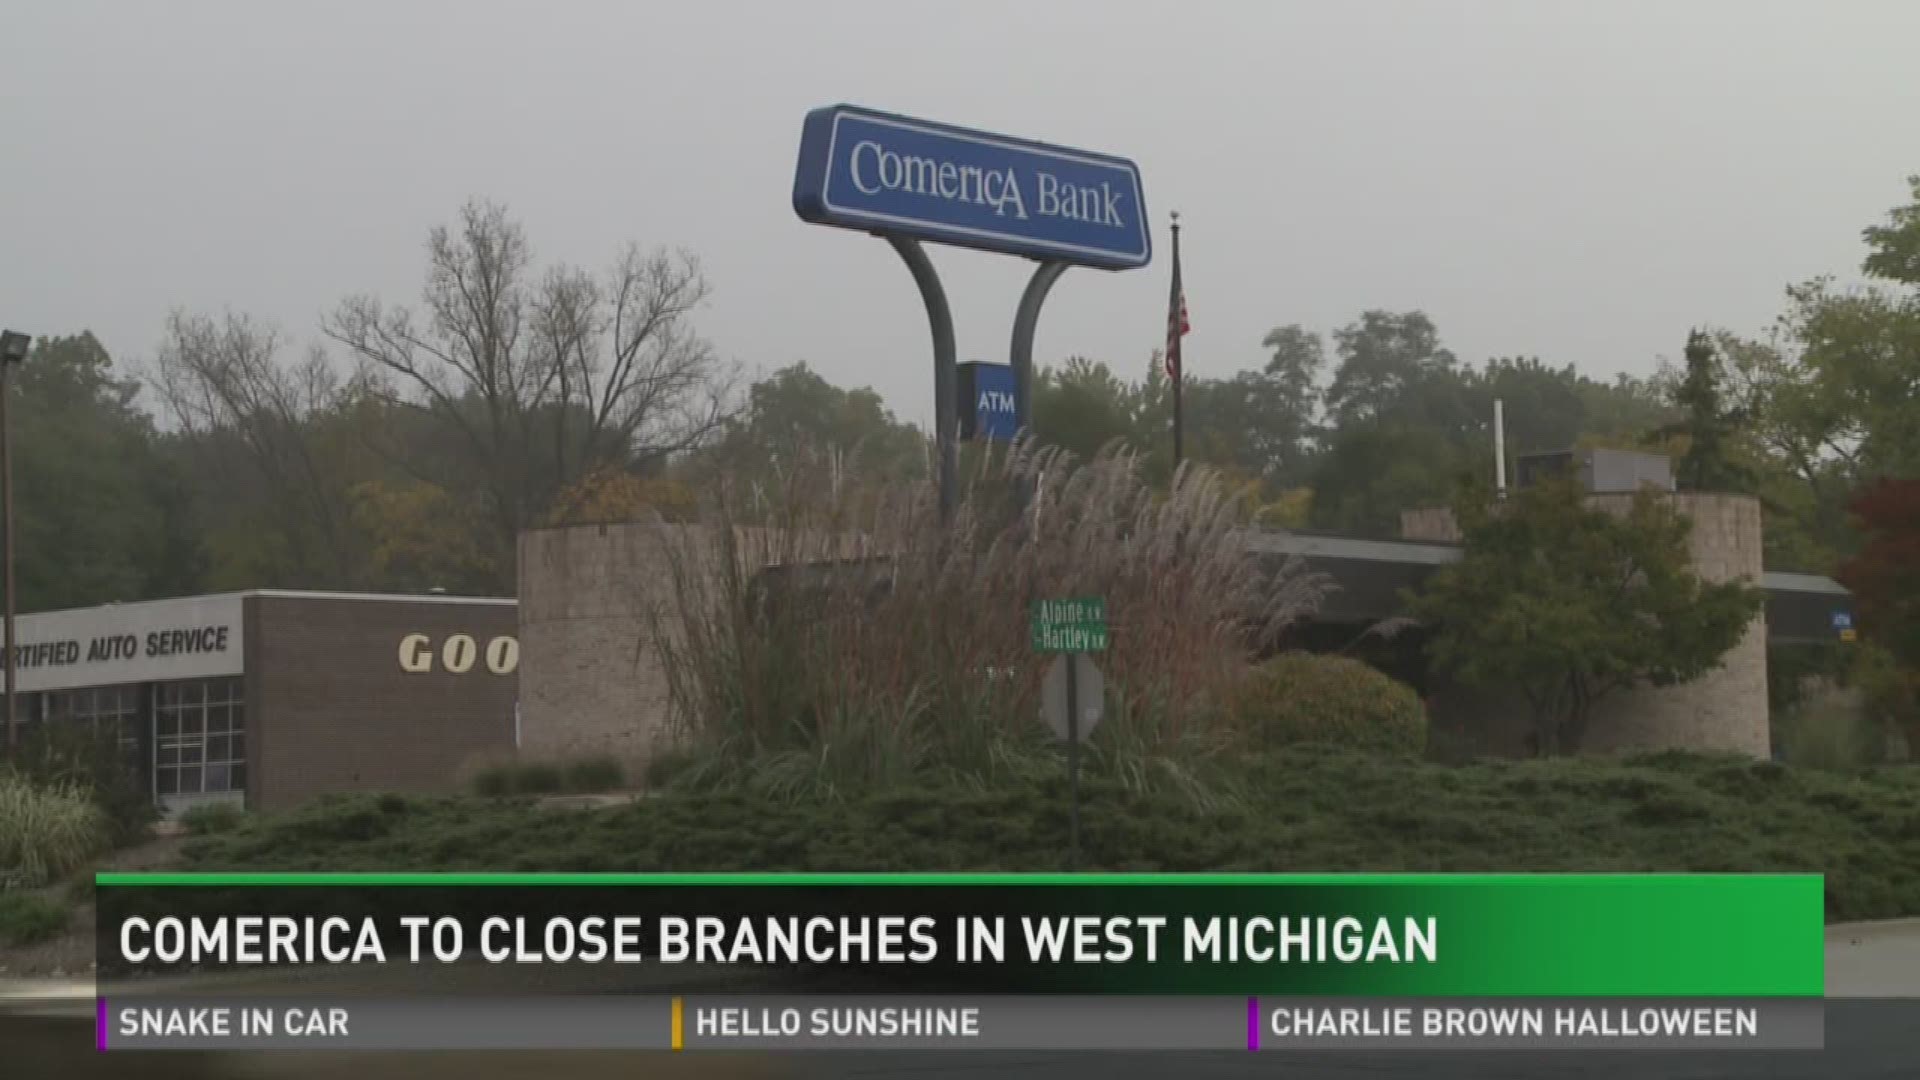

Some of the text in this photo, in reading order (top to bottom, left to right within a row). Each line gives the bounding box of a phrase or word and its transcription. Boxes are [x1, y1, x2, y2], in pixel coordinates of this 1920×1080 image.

[1036, 171, 1125, 228] Bank
[978, 390, 1015, 413] ATM
[1040, 599, 1084, 625] Alpine
[87, 633, 138, 662] AUTO
[145, 625, 229, 658] SERVICE
[1042, 624, 1090, 652] Hartley
